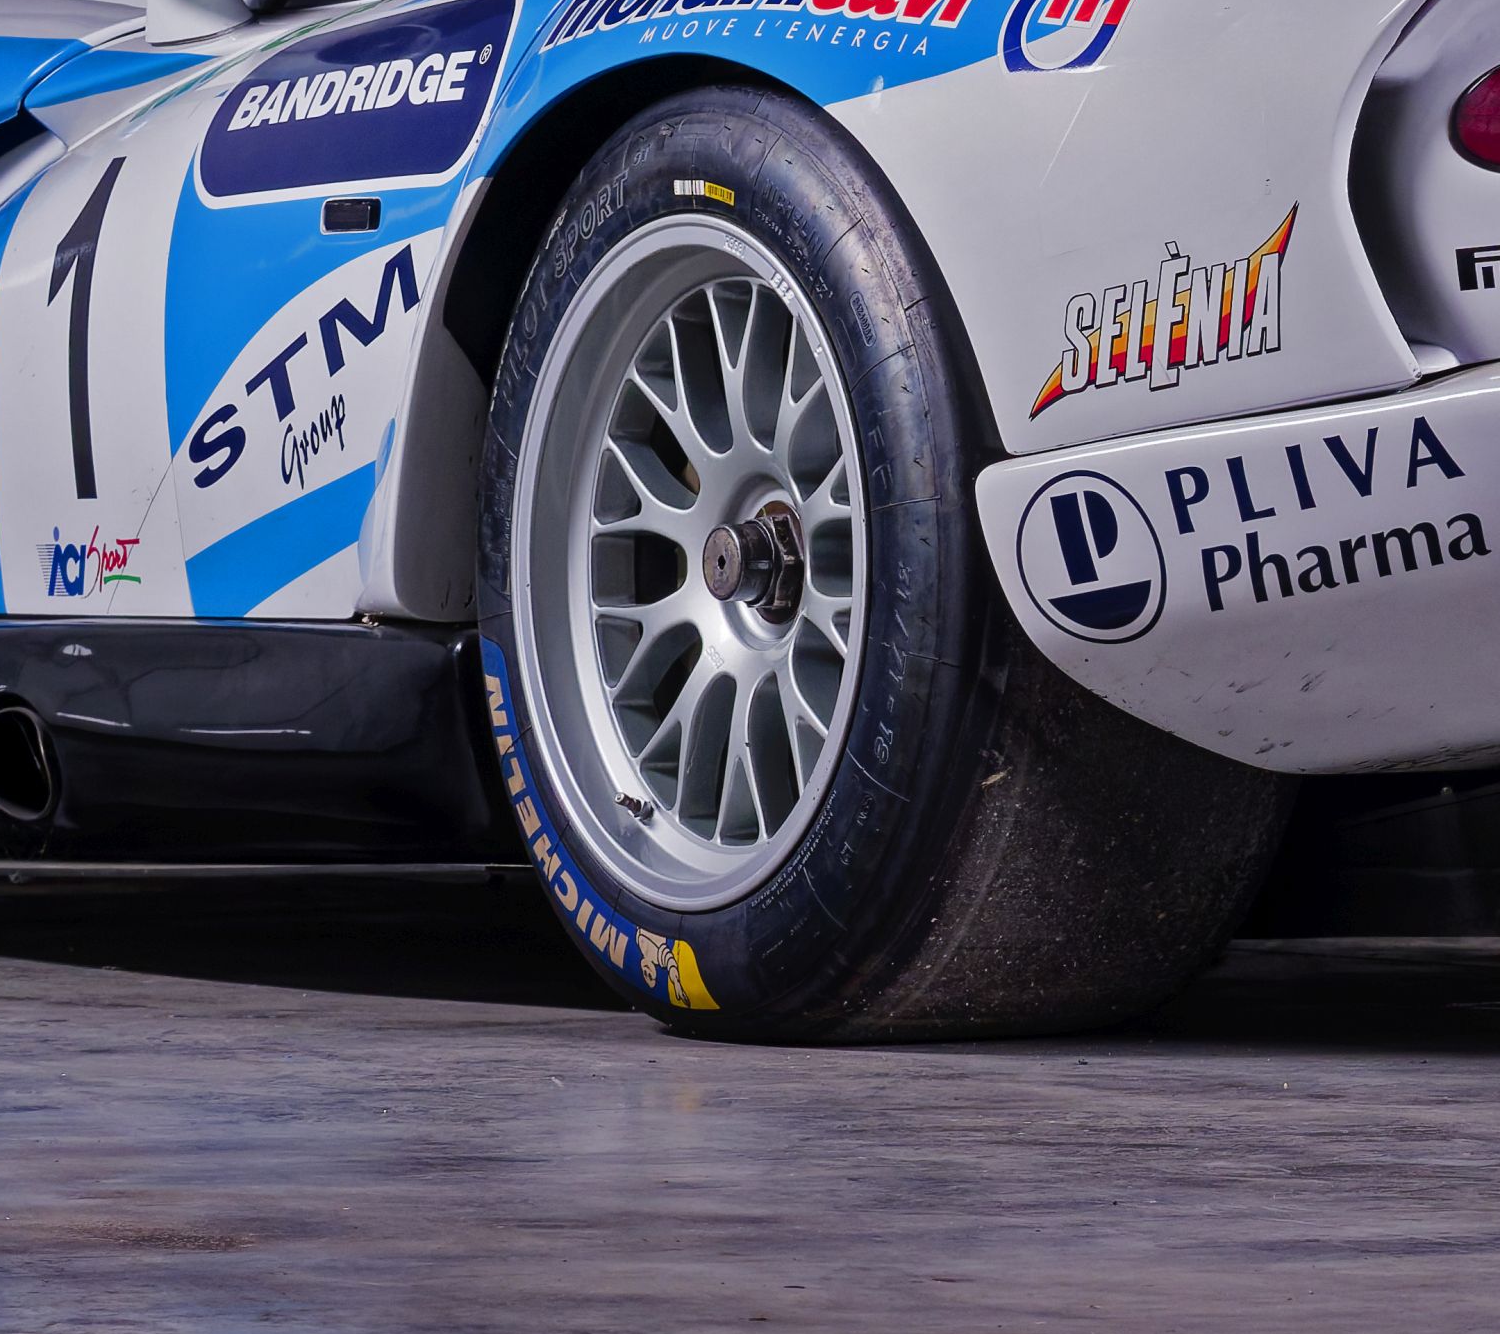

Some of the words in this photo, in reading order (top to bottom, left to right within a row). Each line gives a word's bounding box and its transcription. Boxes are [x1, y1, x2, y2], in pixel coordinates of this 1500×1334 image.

[639, 16, 736, 44] MUOVE
[753, 20, 928, 57] L'ENERGIA
[553, 172, 629, 280] SPORT
[48, 156, 127, 500] 1
[189, 244, 421, 489] STM
[281, 393, 346, 490] Group
[1164, 416, 1466, 535] PLIVA
[1202, 512, 1491, 612] Pharma
[484, 673, 630, 969] MICHELIN
